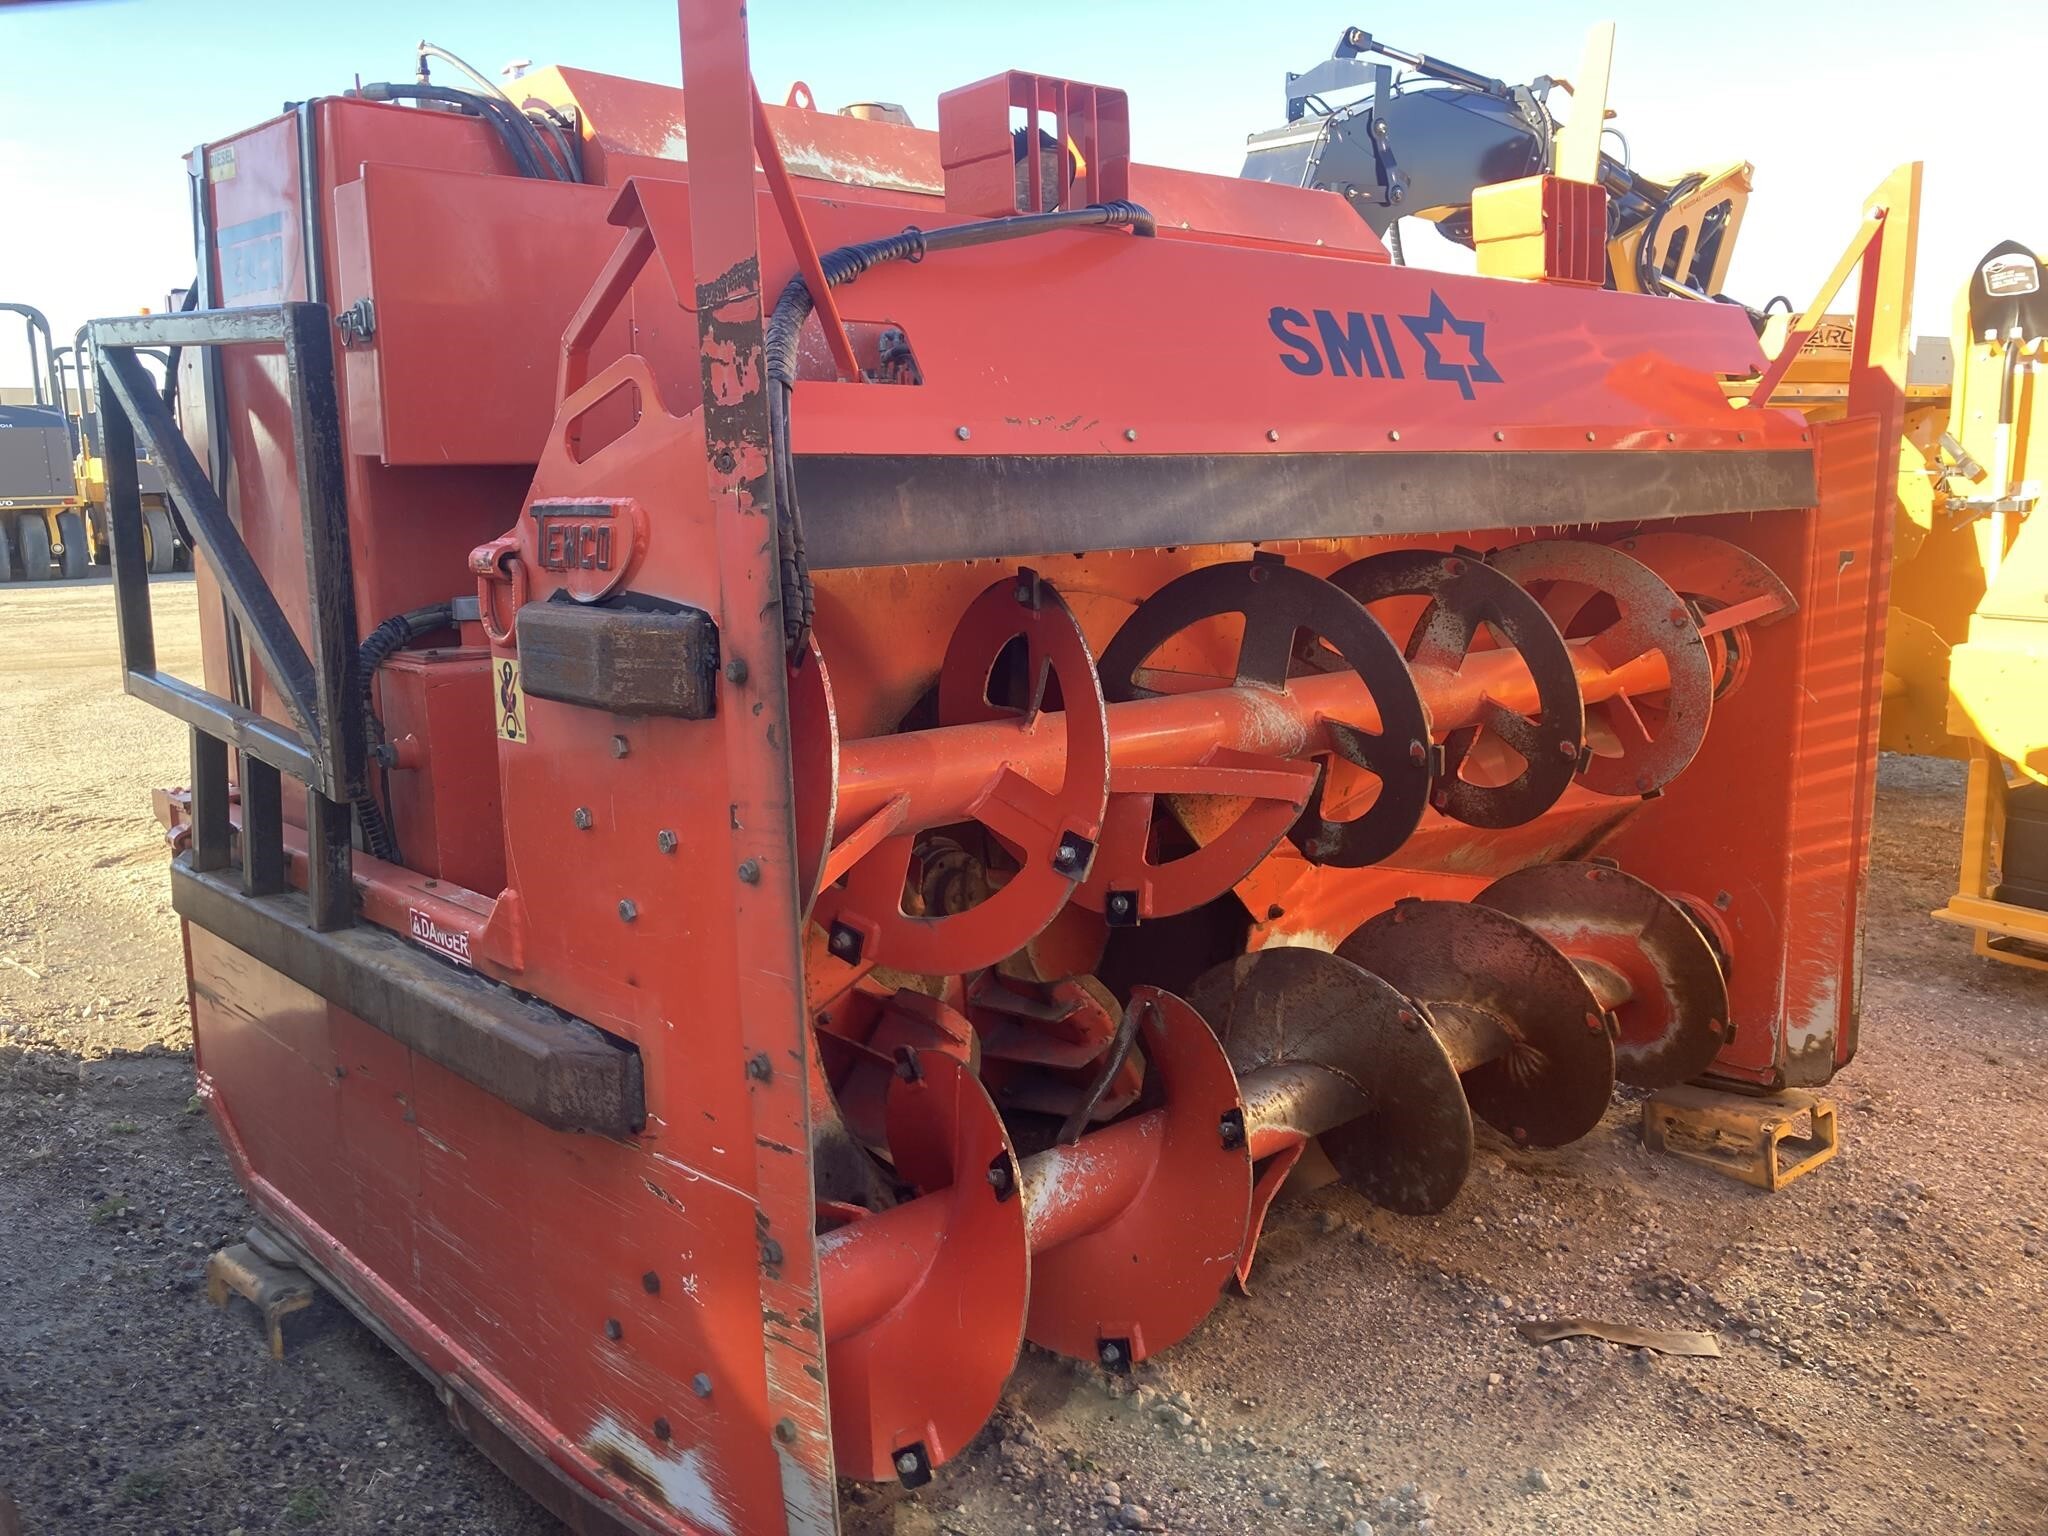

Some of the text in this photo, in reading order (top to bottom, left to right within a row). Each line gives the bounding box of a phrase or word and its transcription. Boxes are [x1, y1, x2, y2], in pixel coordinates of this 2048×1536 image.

[210, 149, 234, 168] DIESEL
[1268, 306, 1405, 380] SMI
[529, 504, 614, 572] TENCO
[421, 917, 470, 957] DANGER
